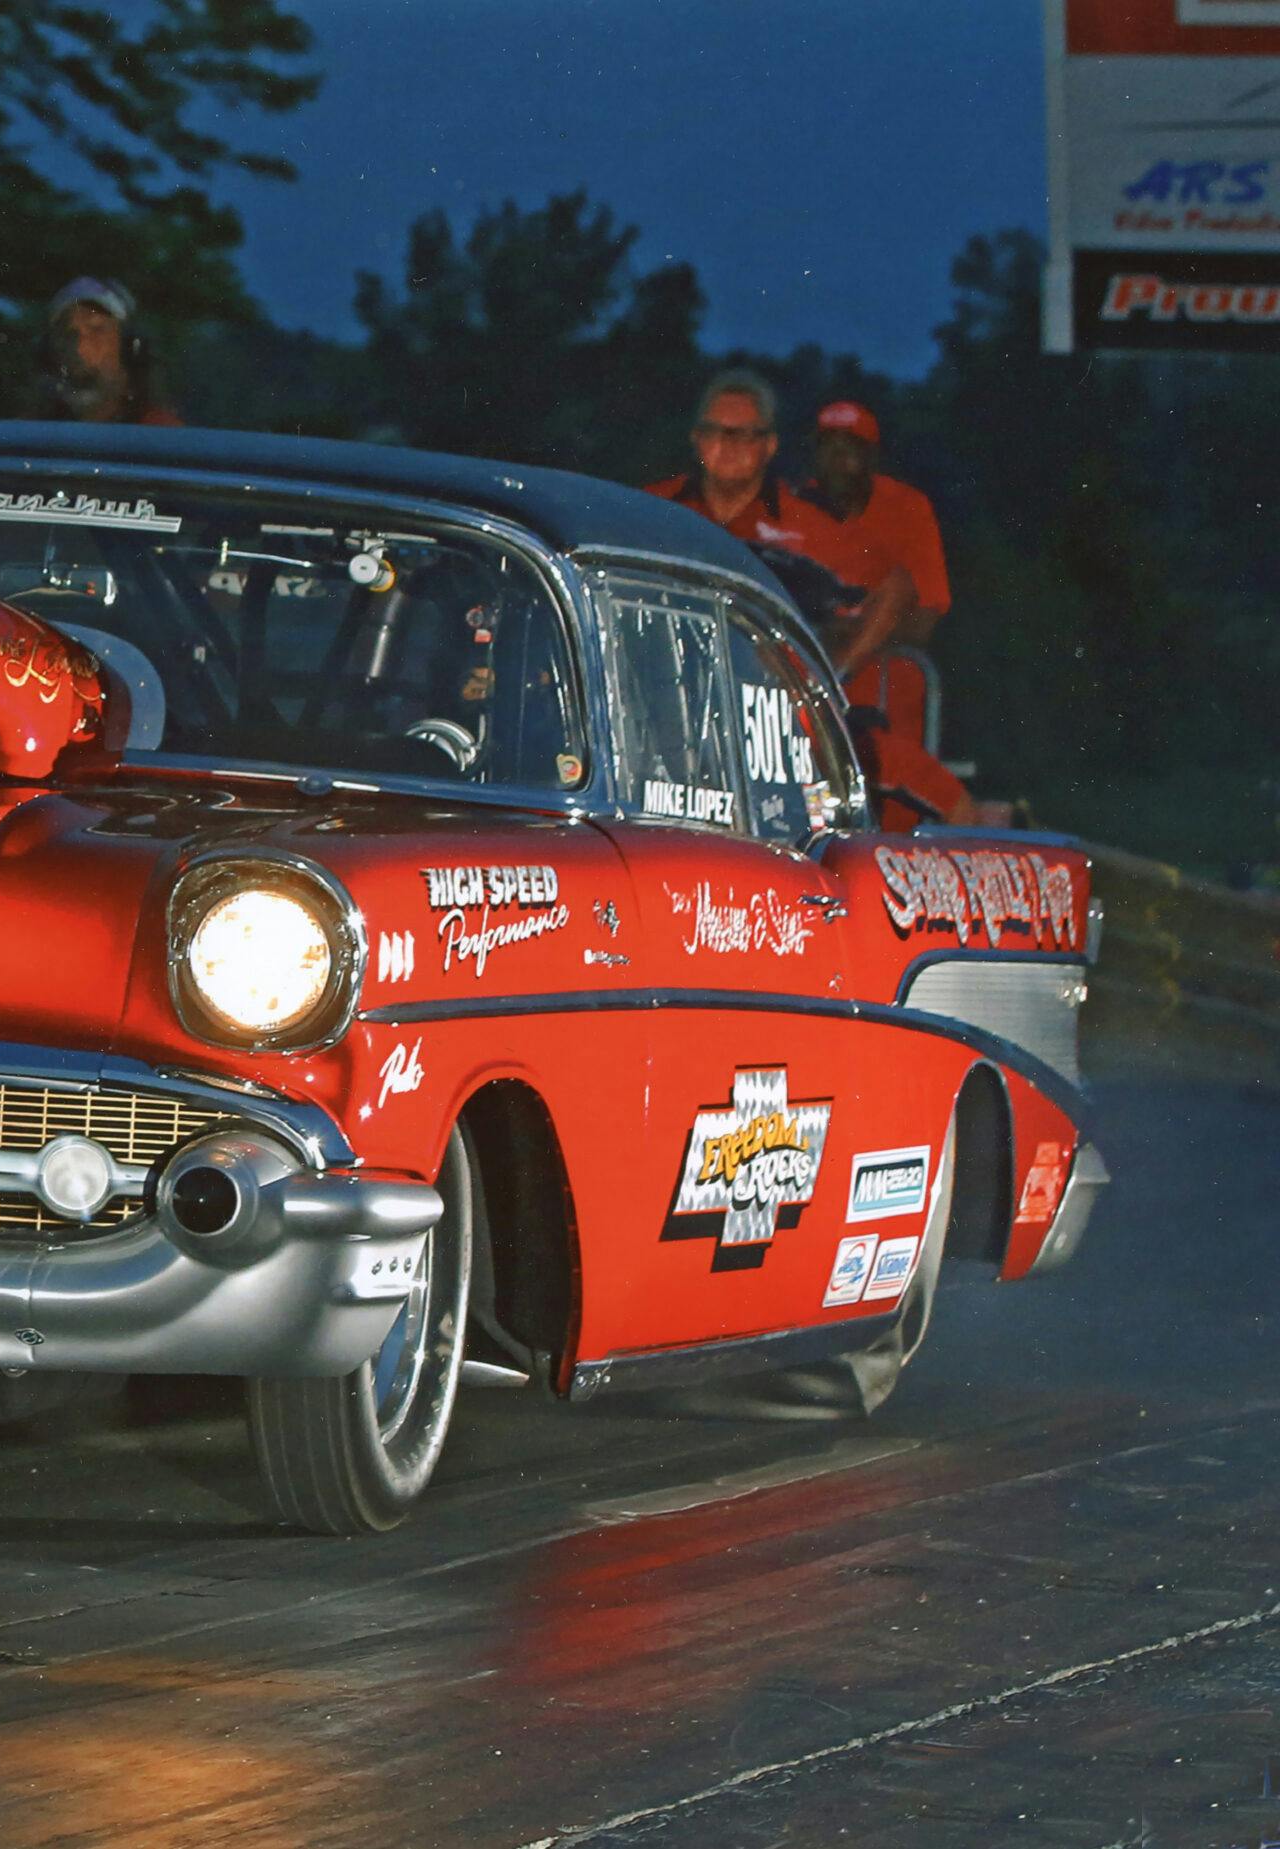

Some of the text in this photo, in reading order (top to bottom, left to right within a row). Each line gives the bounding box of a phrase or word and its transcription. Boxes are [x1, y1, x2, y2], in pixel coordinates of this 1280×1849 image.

[742, 683, 787, 784] 501
[644, 780, 684, 816] MIKE
[686, 785, 734, 825] LOPEZ
[427, 865, 558, 910] HIGH SPEED
[438, 903, 570, 979] Performance
